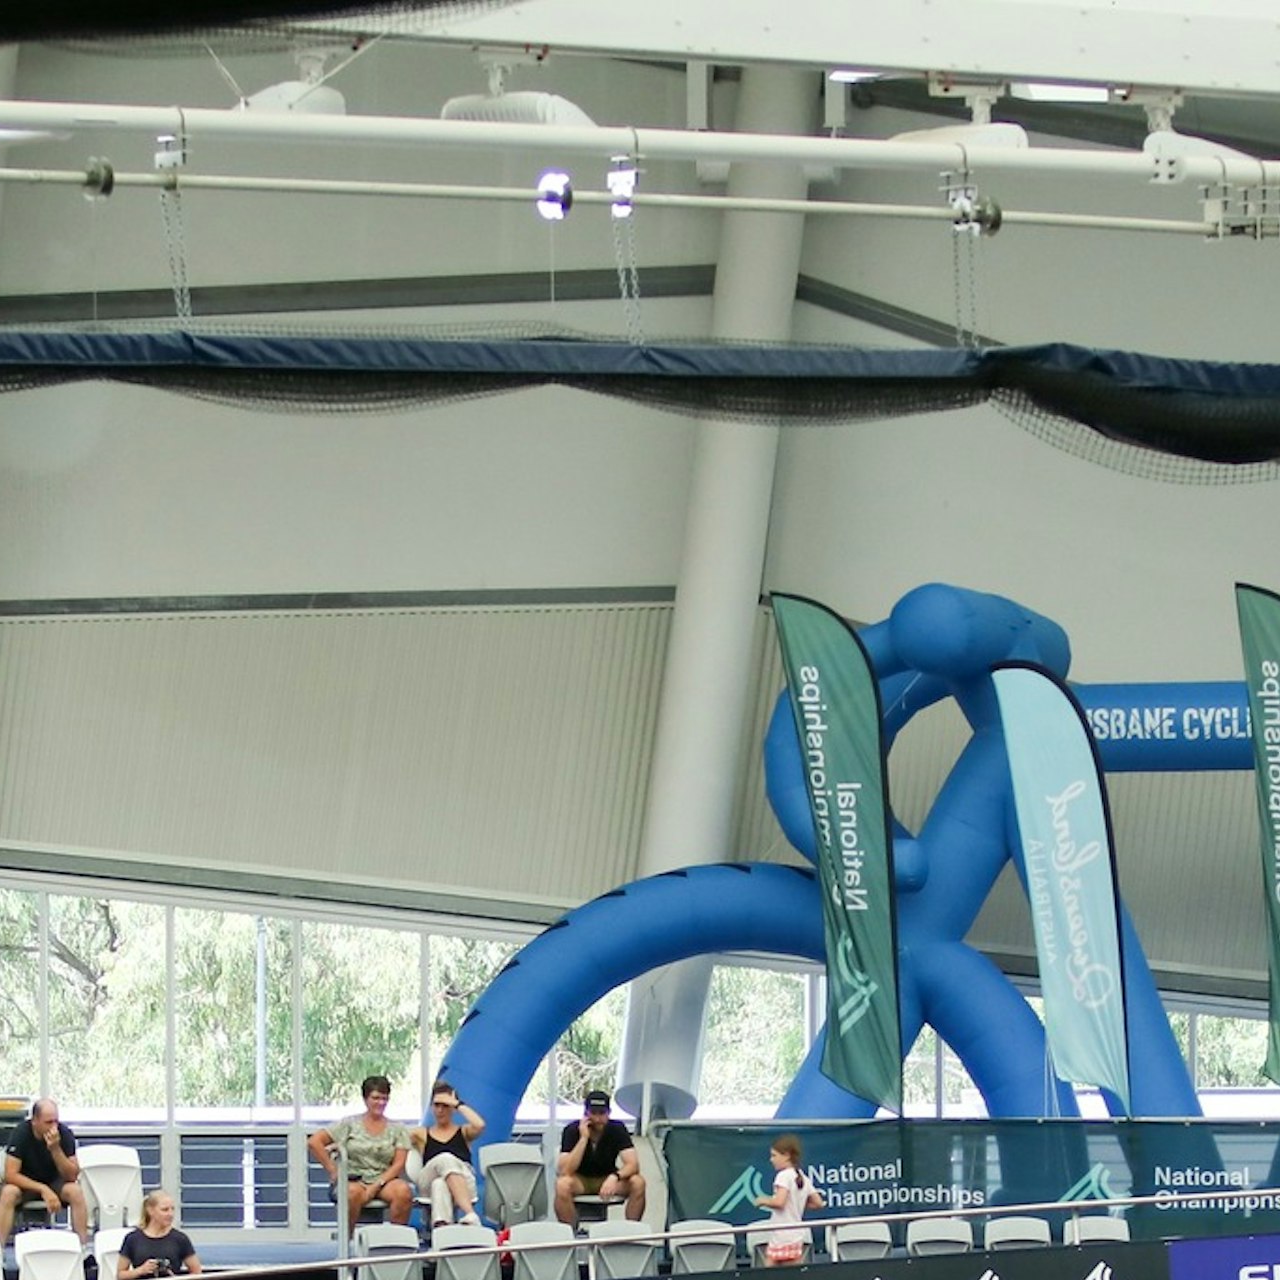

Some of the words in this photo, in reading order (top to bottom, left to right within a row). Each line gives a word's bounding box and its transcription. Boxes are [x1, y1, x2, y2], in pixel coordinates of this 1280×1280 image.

[1086, 706, 1177, 740] SBANE
[1183, 706, 1254, 738] CYCLI
[807, 1158, 902, 1184] National
[1154, 1166, 1249, 1186] National
